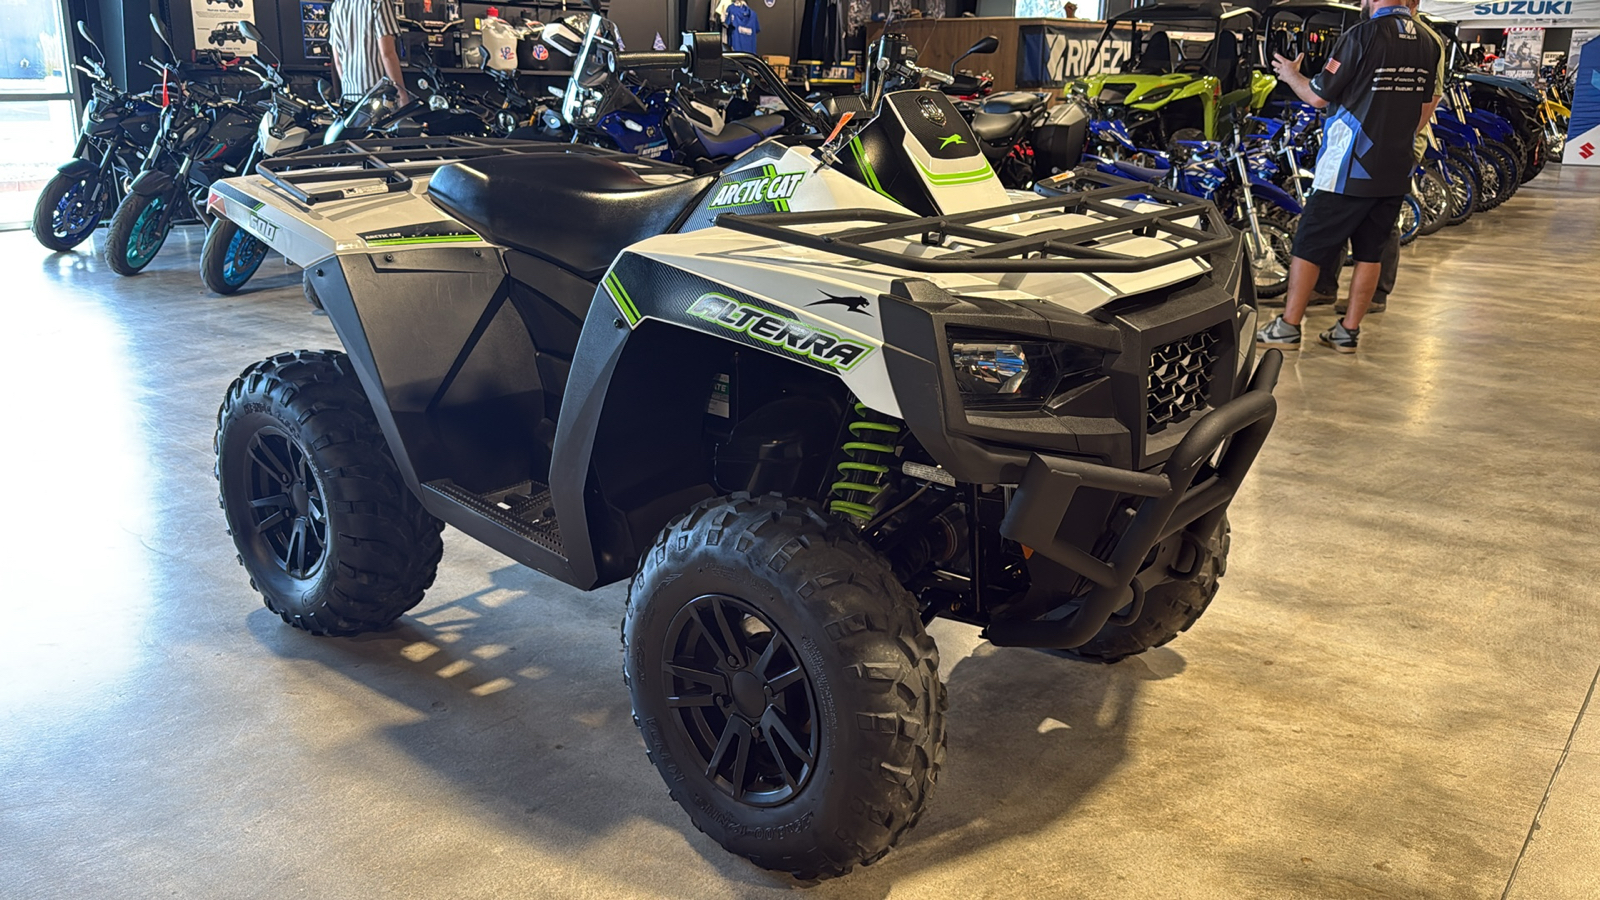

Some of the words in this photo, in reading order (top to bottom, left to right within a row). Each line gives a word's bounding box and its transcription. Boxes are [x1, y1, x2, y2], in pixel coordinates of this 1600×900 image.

[1474, 0, 1572, 15] SUZUKI
[711, 178, 769, 207] ARCTIC
[766, 174, 804, 200] CAT
[691, 296, 866, 366] ALTERRA
